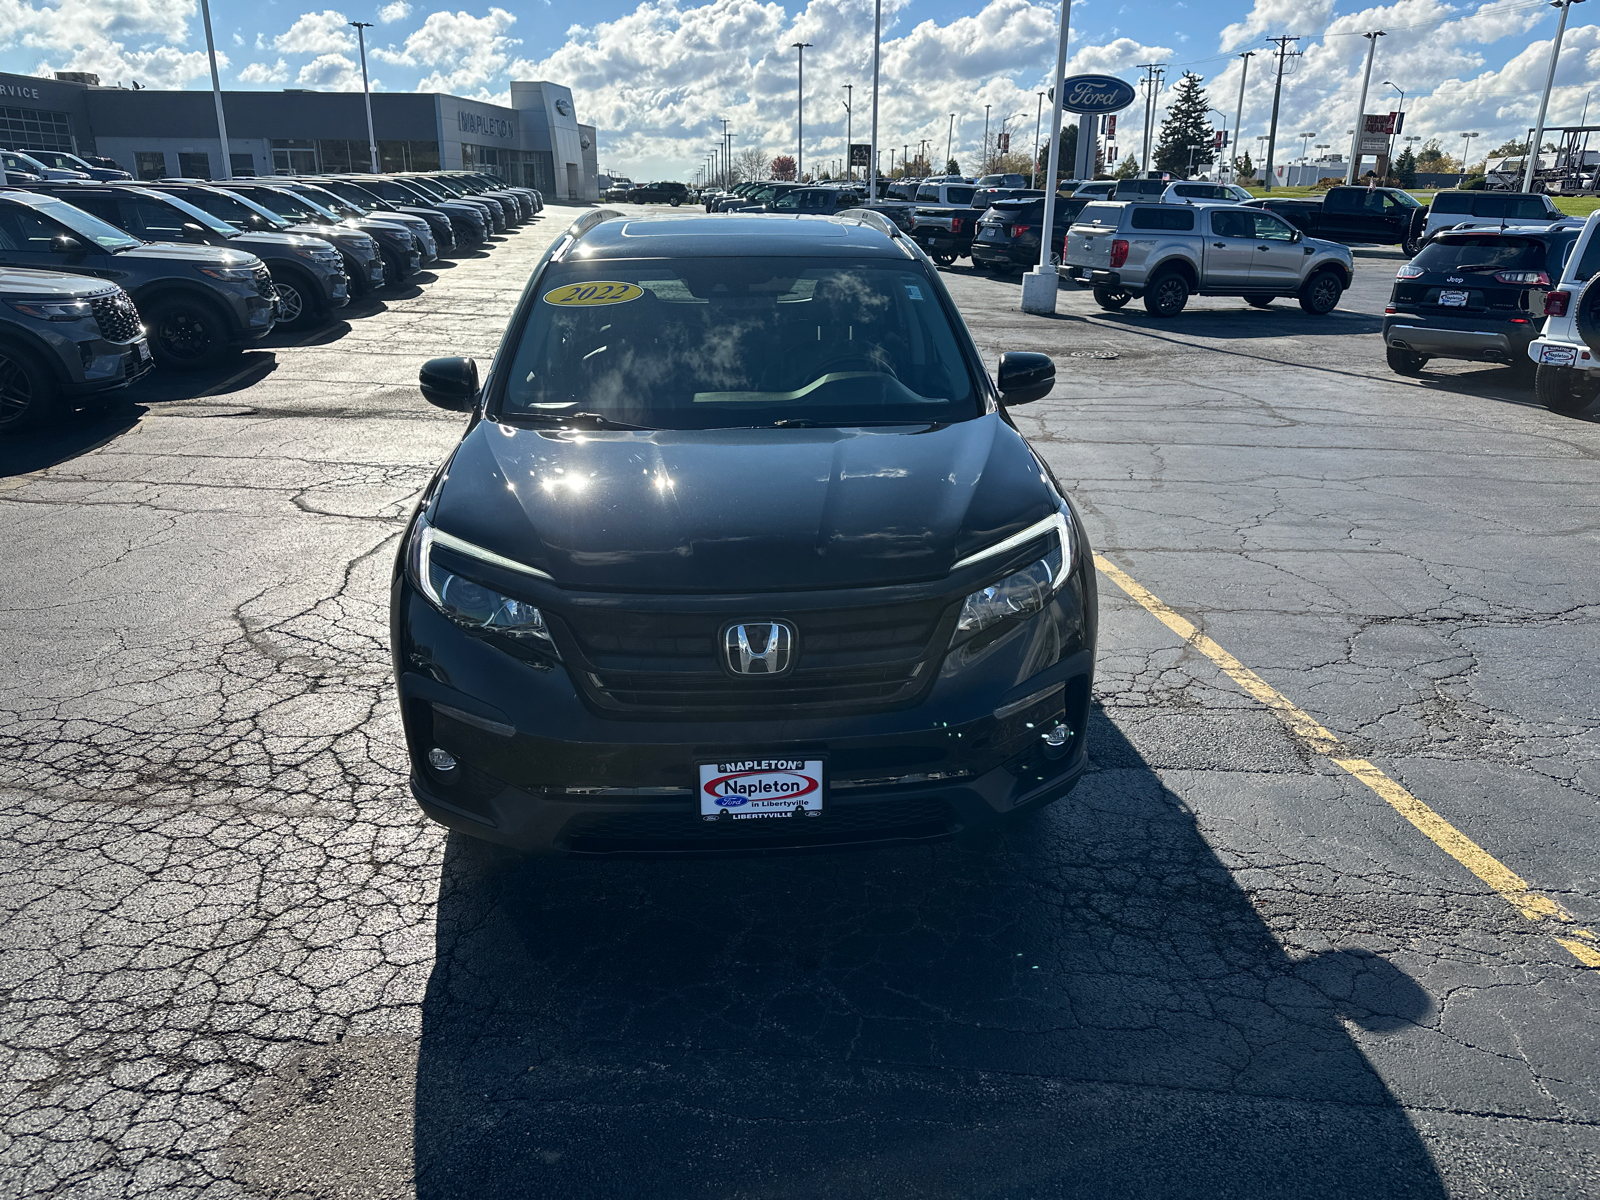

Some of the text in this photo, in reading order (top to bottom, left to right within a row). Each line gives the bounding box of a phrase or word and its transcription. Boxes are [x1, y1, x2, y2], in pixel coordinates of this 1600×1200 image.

[1068, 82, 1119, 104] Ford
[458, 110, 515, 139] NAPLETON
[1446, 276, 1464, 284] Jeep
[560, 286, 629, 302] 2022
[1547, 351, 1570, 359] Napleton
[726, 760, 797, 772] NAPLETON
[724, 780, 800, 797] Napleton
[721, 797, 742, 806] Ford
[732, 812, 793, 820] LIBERTYVILLE
